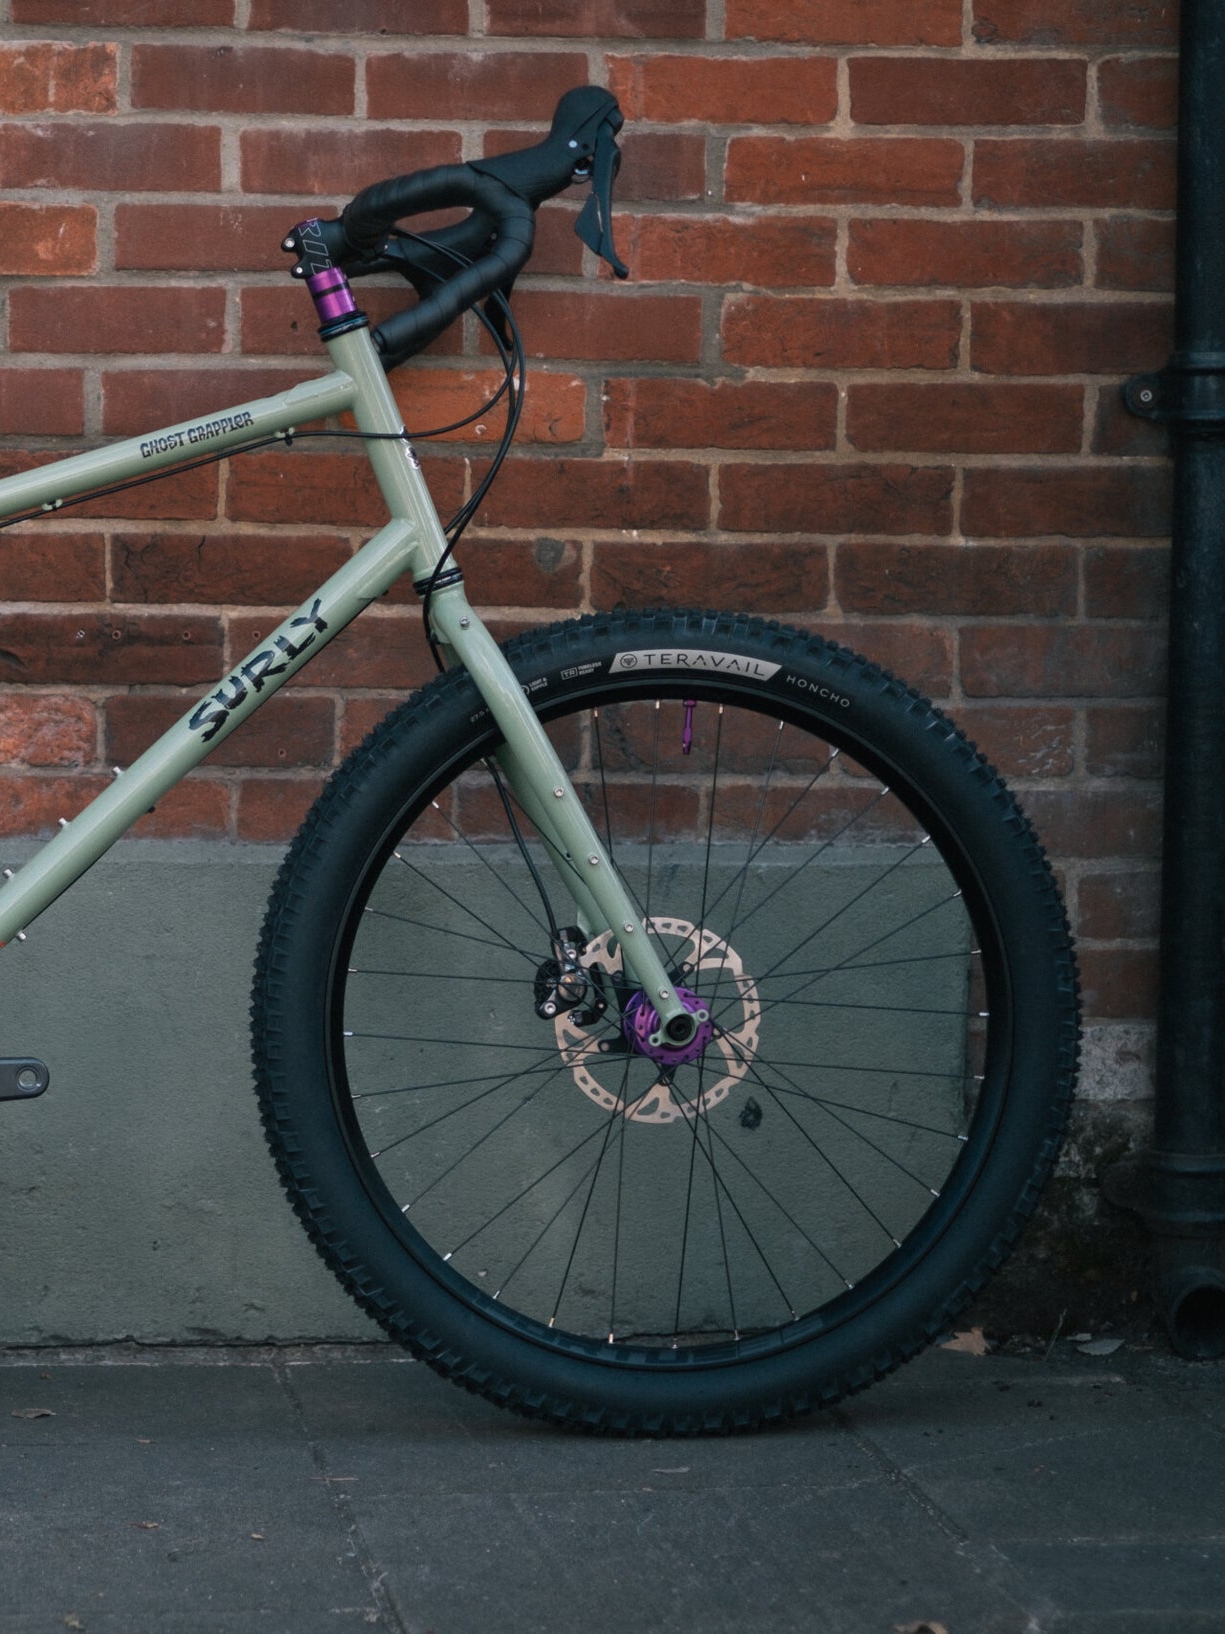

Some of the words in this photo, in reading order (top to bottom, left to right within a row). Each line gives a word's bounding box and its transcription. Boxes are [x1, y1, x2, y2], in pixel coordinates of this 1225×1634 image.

[140, 432, 186, 458] GHOST
[187, 411, 254, 443] GRAPPLER
[188, 598, 328, 742] SURLY
[644, 653, 765, 676] TERAVAIL
[786, 674, 851, 708] HONCHO
